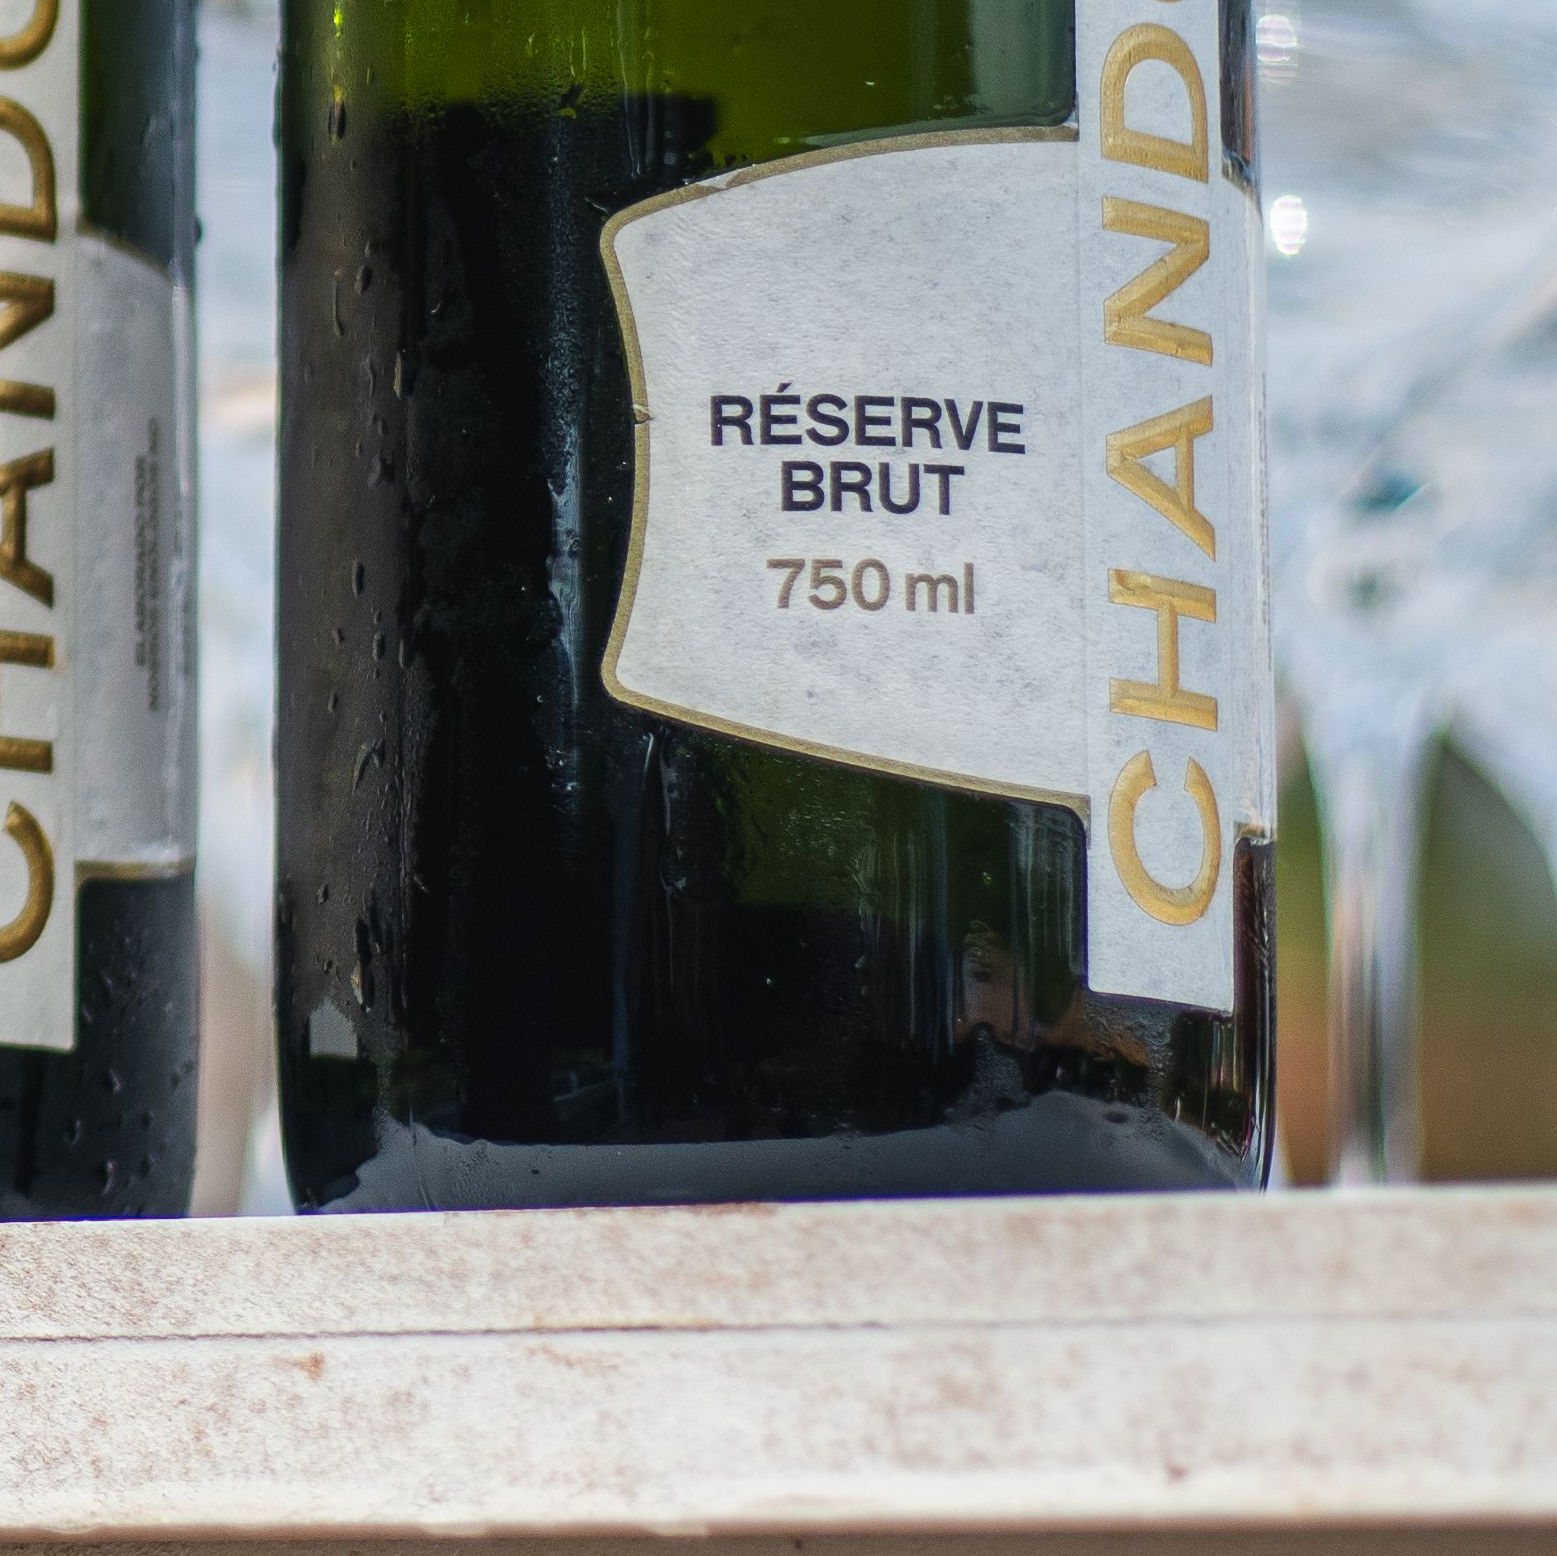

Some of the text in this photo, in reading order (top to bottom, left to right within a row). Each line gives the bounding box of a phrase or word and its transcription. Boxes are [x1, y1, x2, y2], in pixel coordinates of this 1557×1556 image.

[709, 381, 1027, 455] RÉSERVE
[779, 460, 965, 516] BRUT
[765, 557, 977, 616] 750 ml
